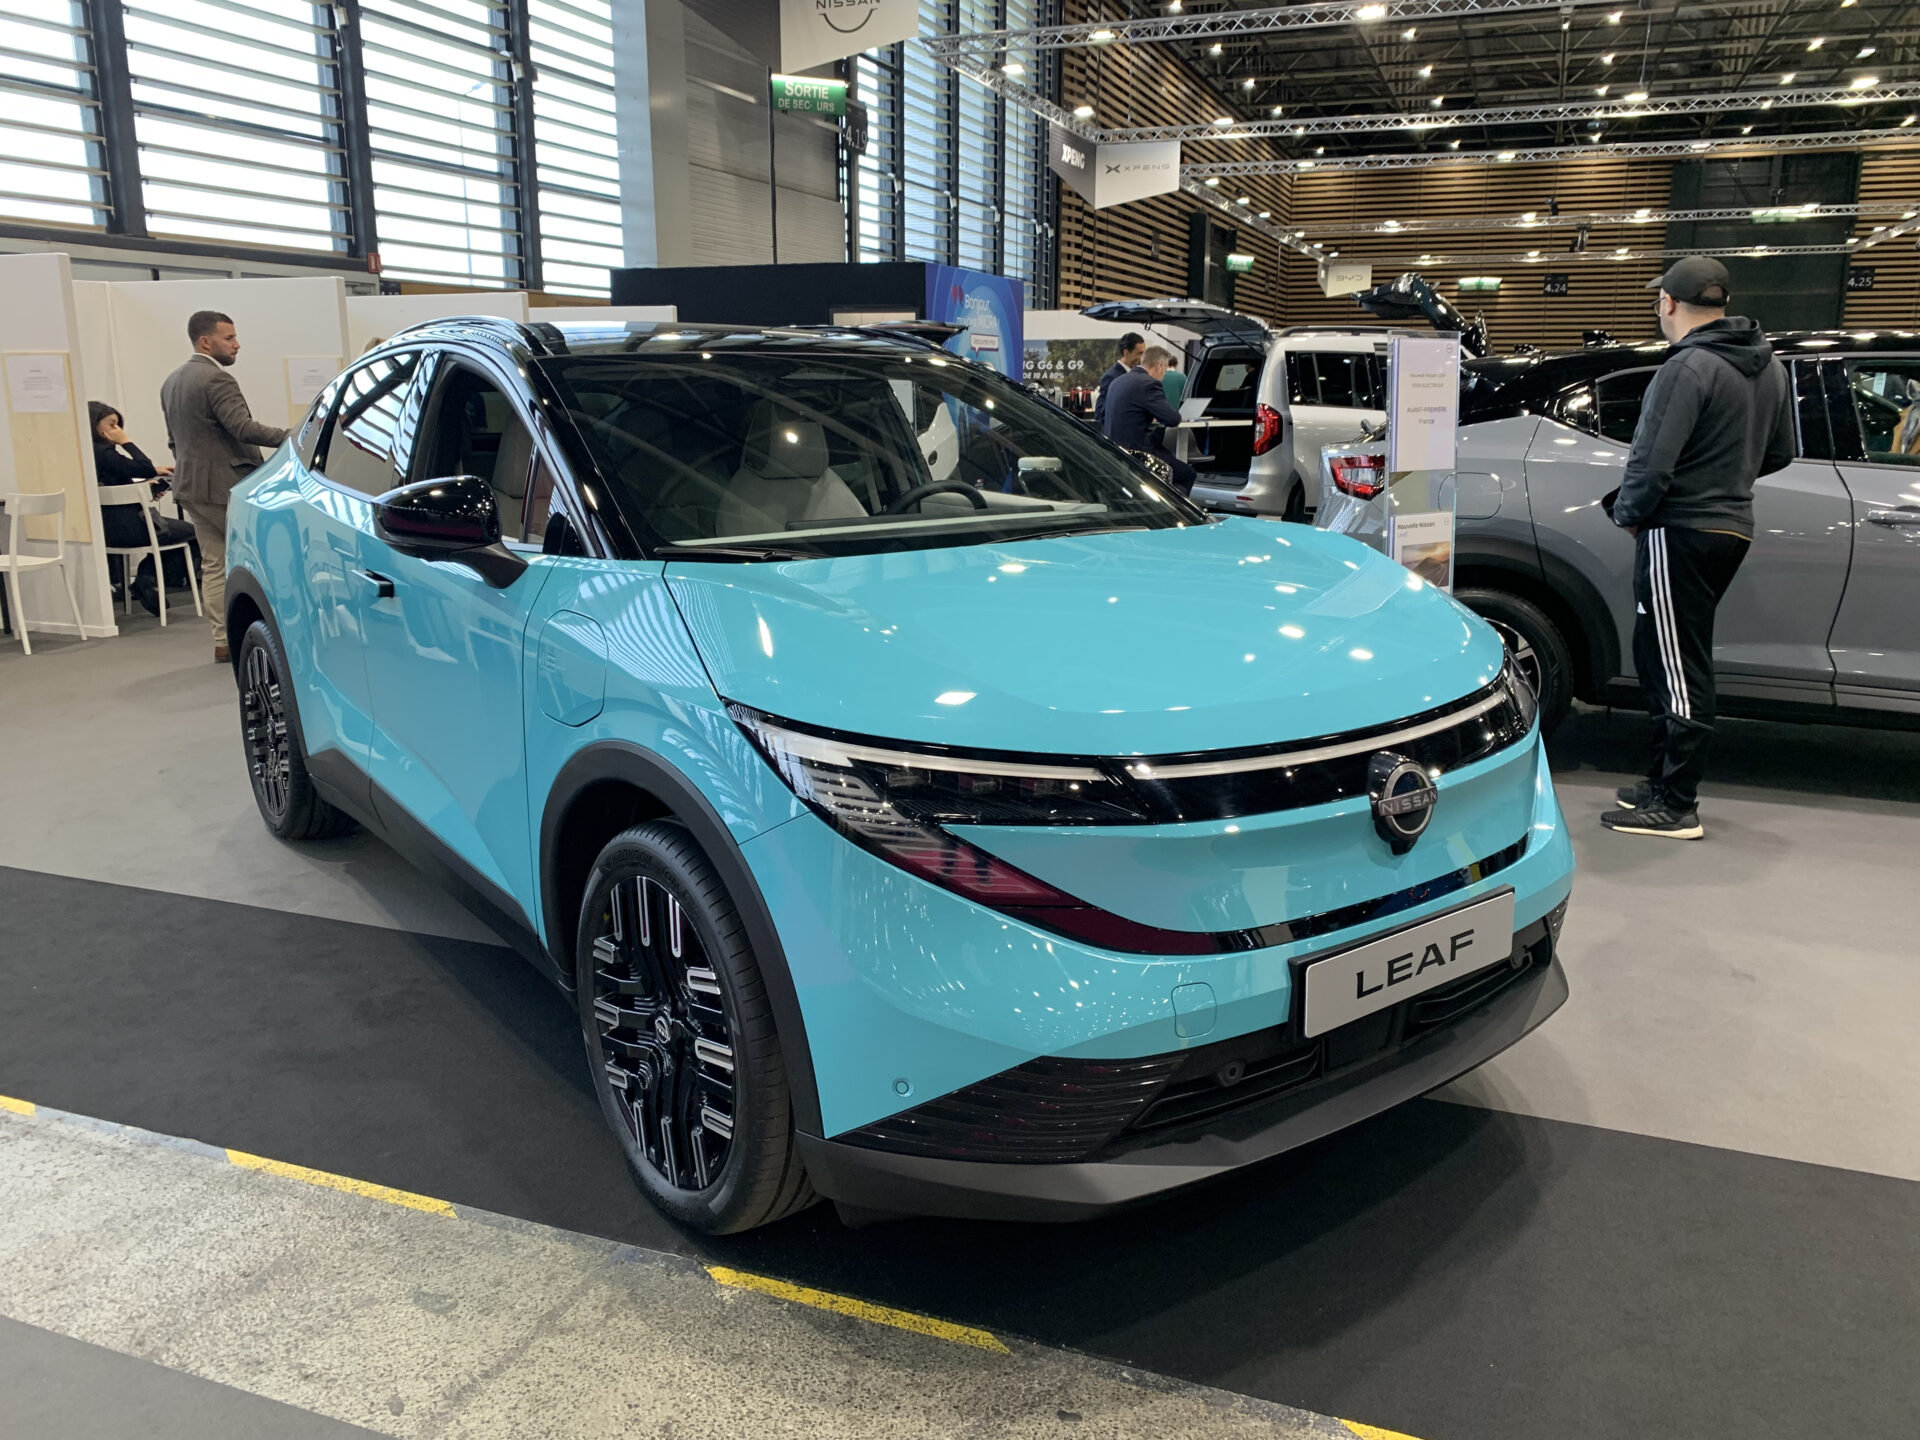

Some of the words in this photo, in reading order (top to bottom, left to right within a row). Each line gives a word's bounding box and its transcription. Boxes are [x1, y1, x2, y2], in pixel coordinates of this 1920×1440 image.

[784, 82, 829, 99] SORTIE
[778, 98, 791, 108] DE
[846, 125, 867, 150] 4.19
[1061, 143, 1085, 169] XPENG
[1545, 283, 1566, 292] 4.24
[1848, 276, 1872, 287] 4.25
[1037, 360, 1053, 370] G6
[1056, 360, 1065, 370] &
[1067, 360, 1084, 370] G9
[1033, 372, 1041, 380] 10
[1381, 790, 1438, 814] NISSAN
[1356, 928, 1475, 999] LEAF
